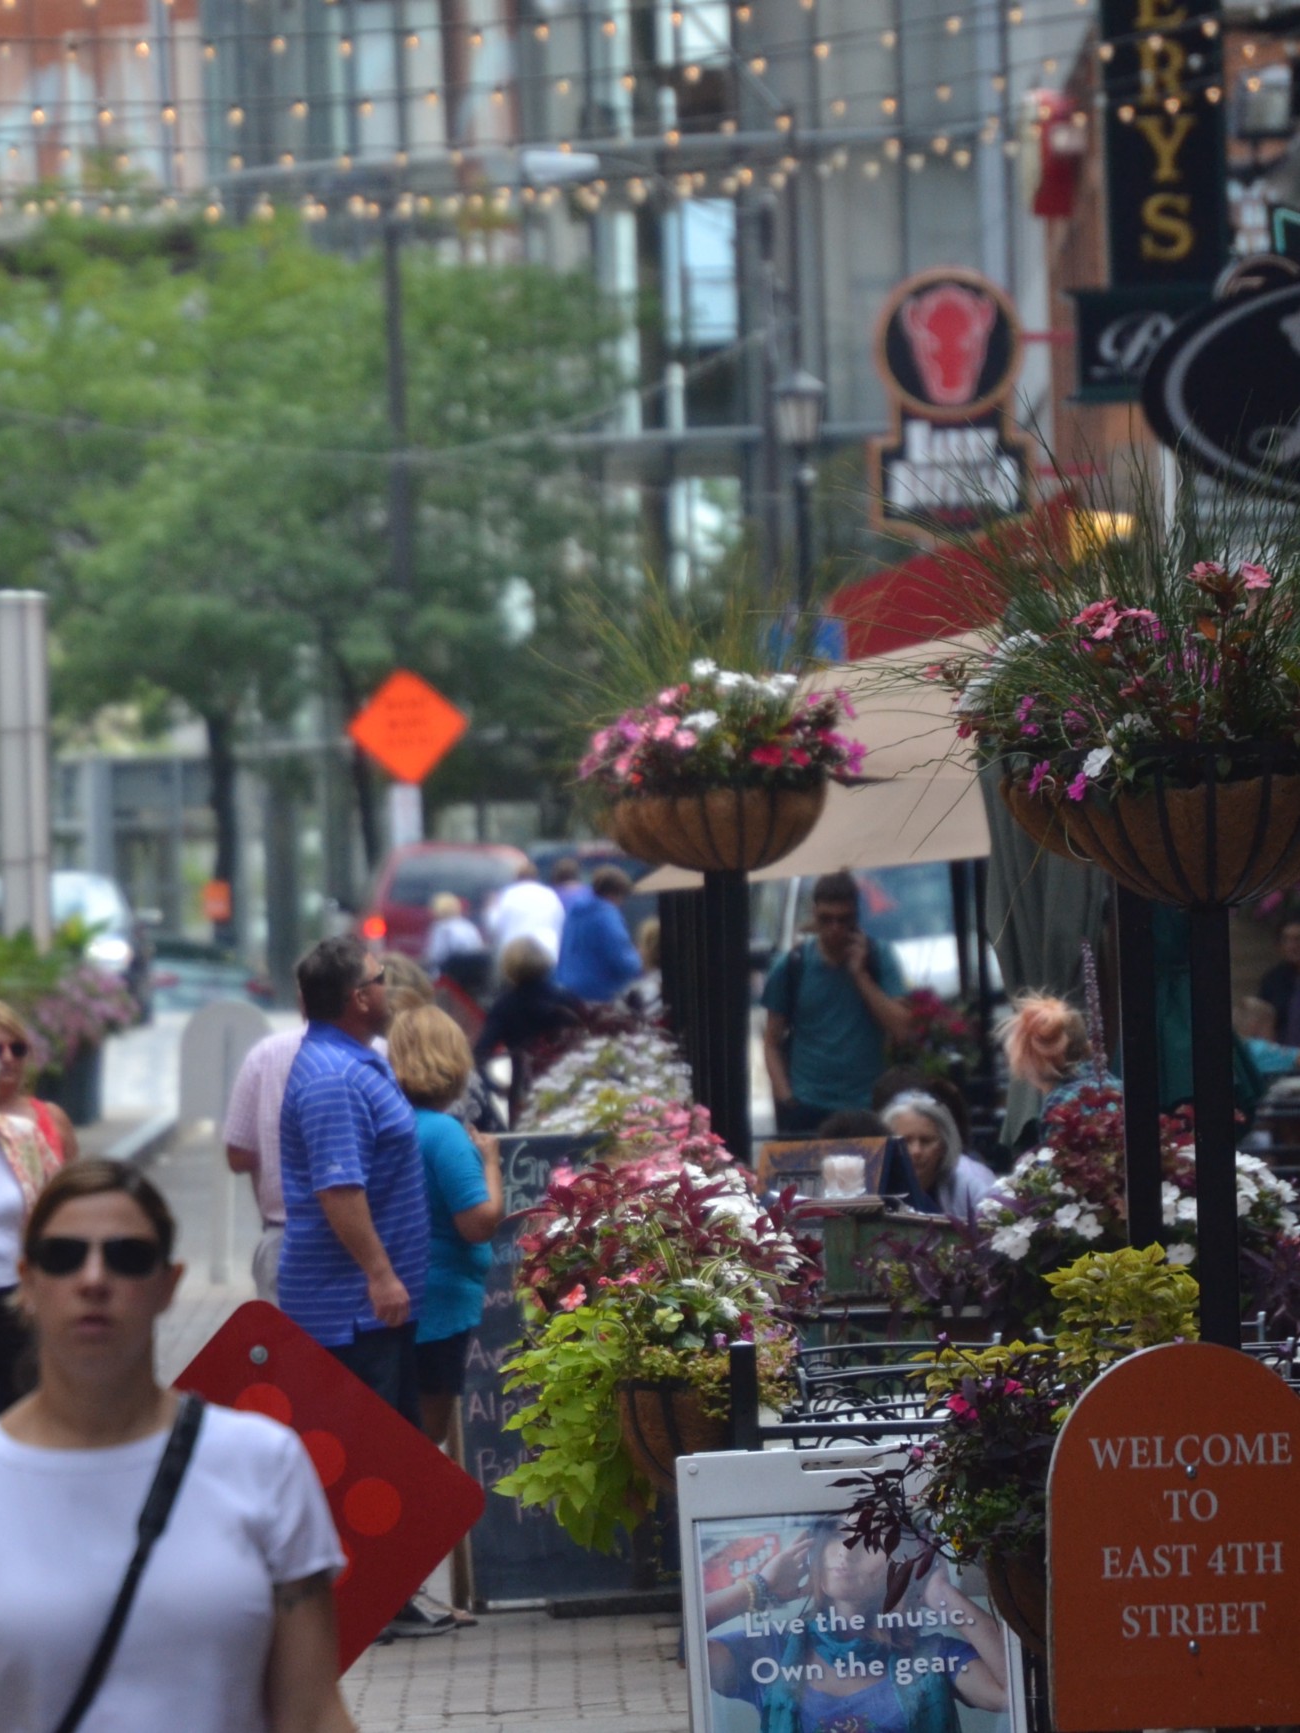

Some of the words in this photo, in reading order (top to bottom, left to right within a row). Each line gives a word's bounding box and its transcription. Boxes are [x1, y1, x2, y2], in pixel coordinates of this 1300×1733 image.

[1089, 1432, 1293, 1469] WELCOME
[1163, 1489, 1219, 1522] TO
[1101, 1545, 1197, 1579] EAST
[1207, 1542, 1284, 1576] 4TH
[744, 1612, 805, 1638] Live
[815, 1606, 865, 1632] the
[877, 1601, 975, 1630] music.
[1122, 1601, 1267, 1639] STREET
[751, 1657, 824, 1684] Own
[834, 1652, 884, 1678] the
[895, 1654, 968, 1685] gear.
